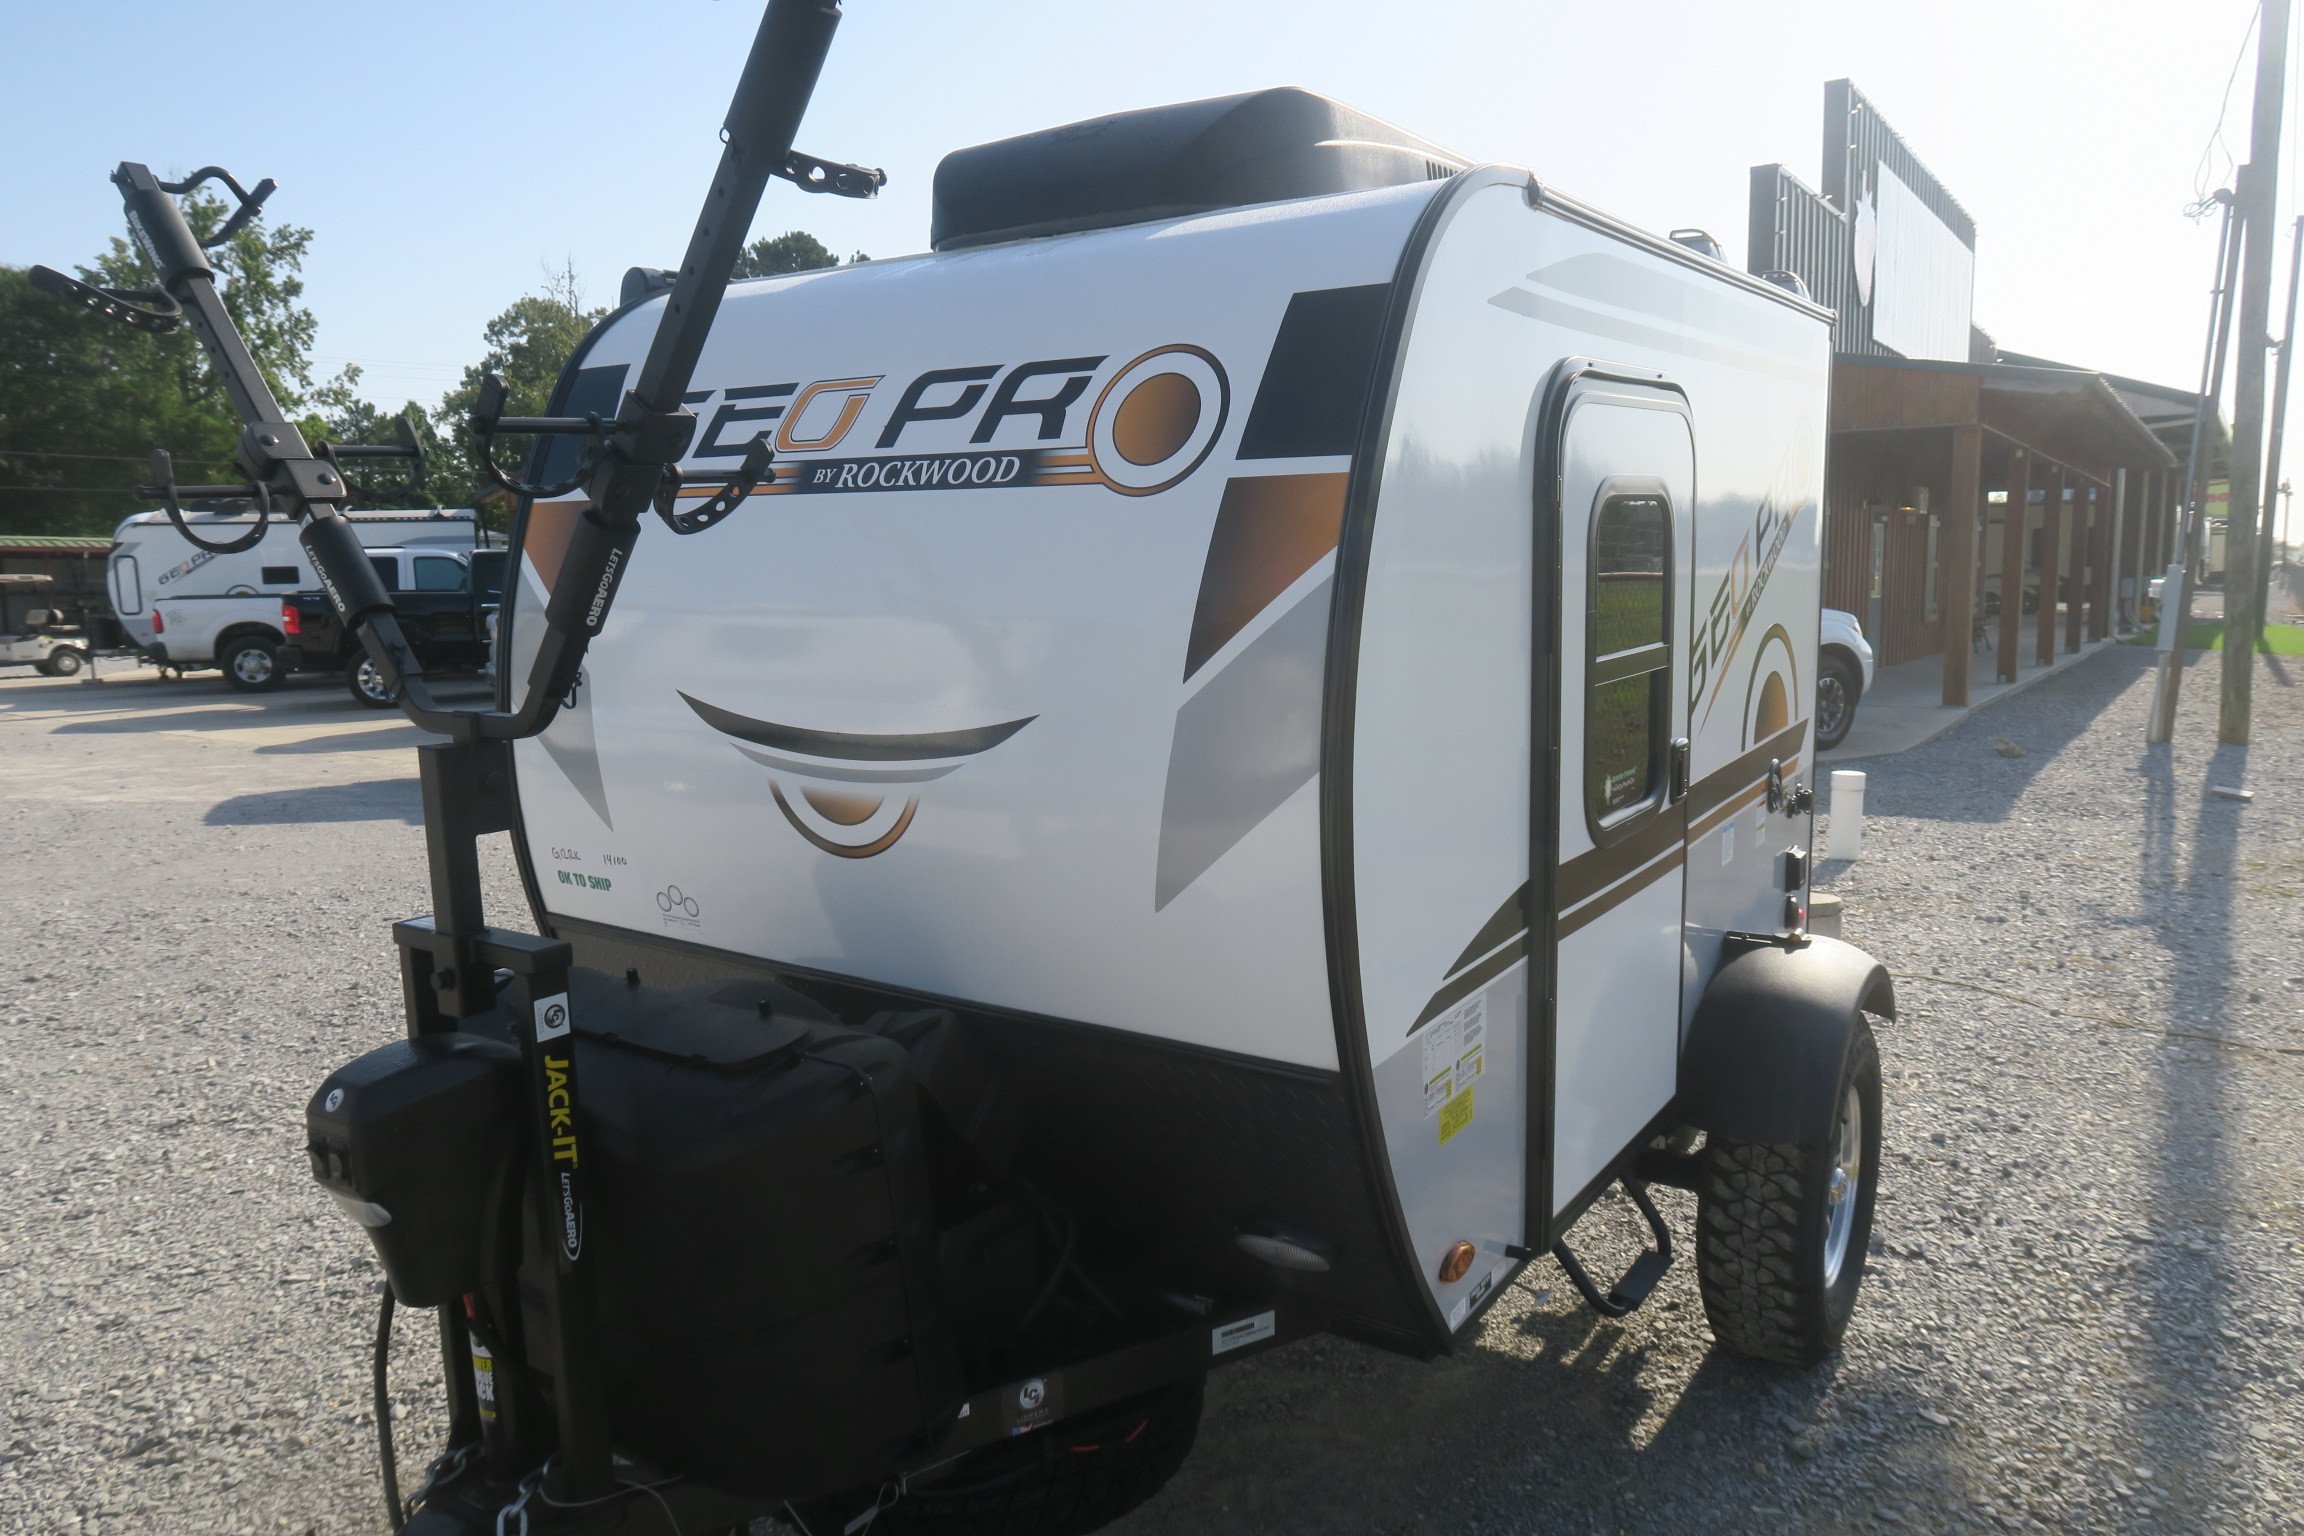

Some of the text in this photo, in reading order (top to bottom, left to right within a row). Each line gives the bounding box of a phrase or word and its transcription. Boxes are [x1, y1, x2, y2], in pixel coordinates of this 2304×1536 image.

[812, 455, 1021, 488] BY ROCKWOOD
[558, 869, 612, 892] OK TO SHIP
[544, 1054, 579, 1164] JACK-IT
